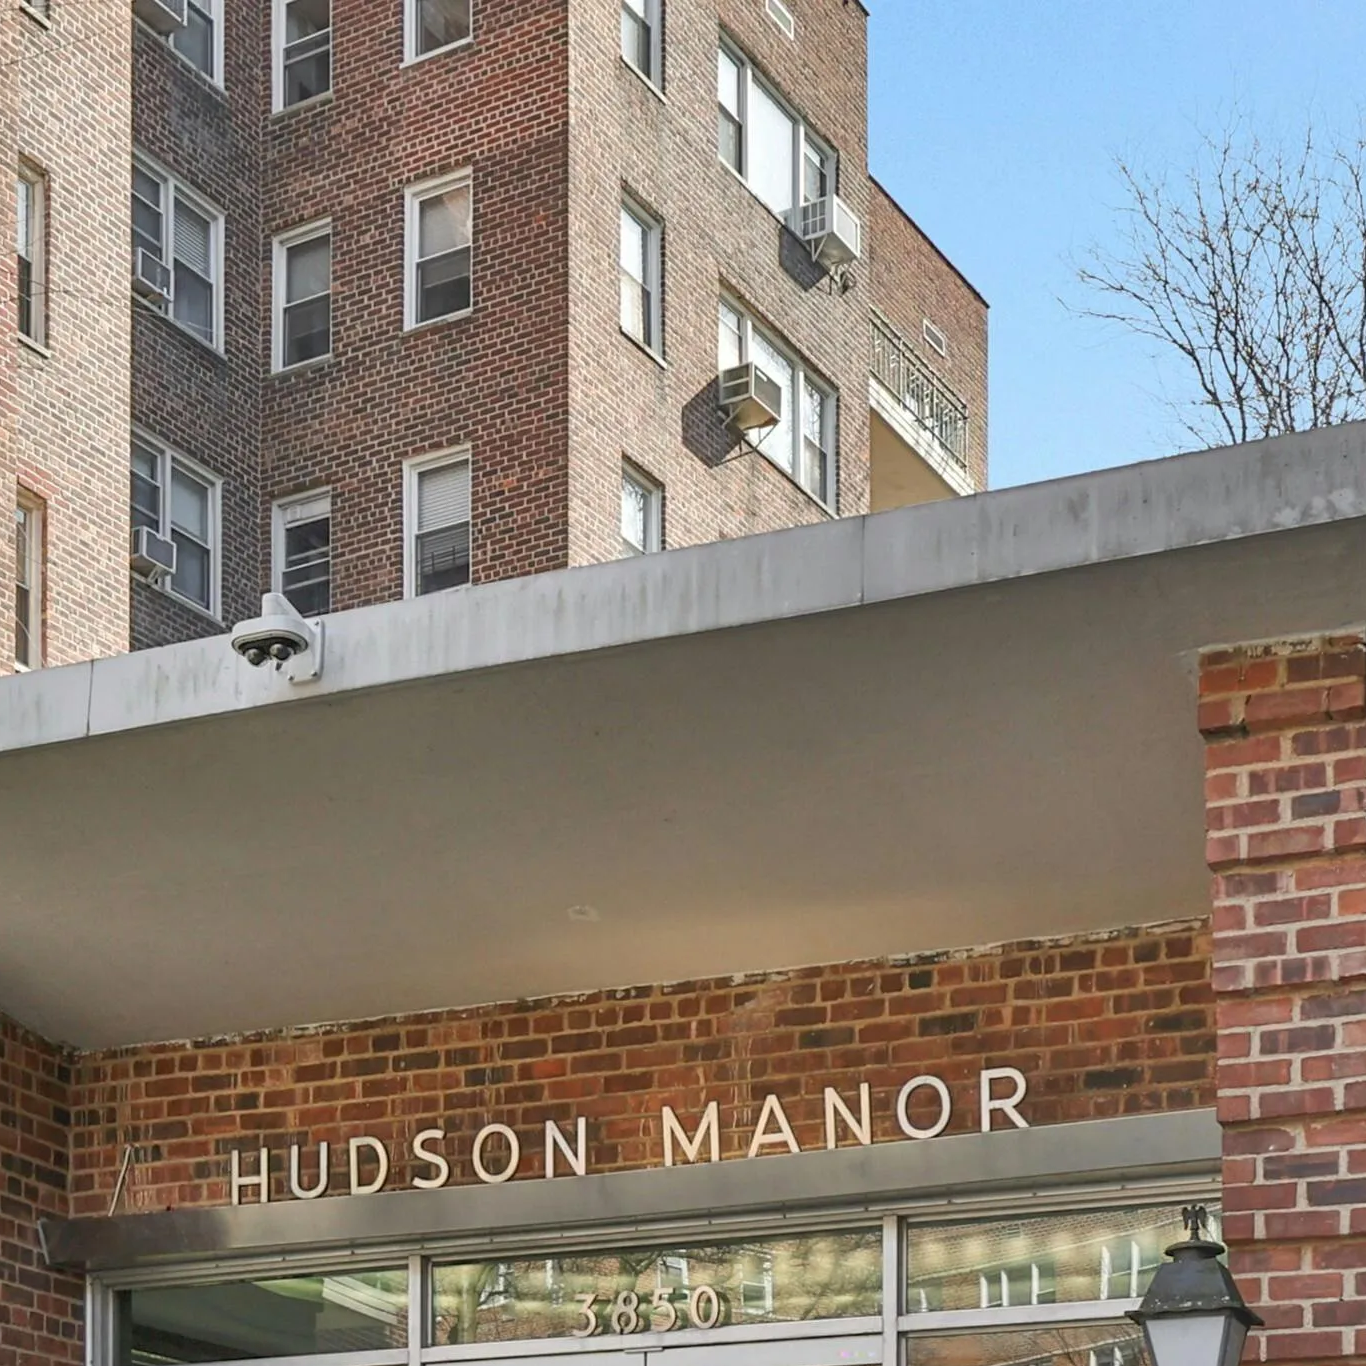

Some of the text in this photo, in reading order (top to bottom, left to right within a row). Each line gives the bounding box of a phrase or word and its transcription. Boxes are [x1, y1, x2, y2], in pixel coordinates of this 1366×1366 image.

[229, 1066, 1031, 1206] HUDSON MANOR
[571, 1284, 719, 1338] 3850
